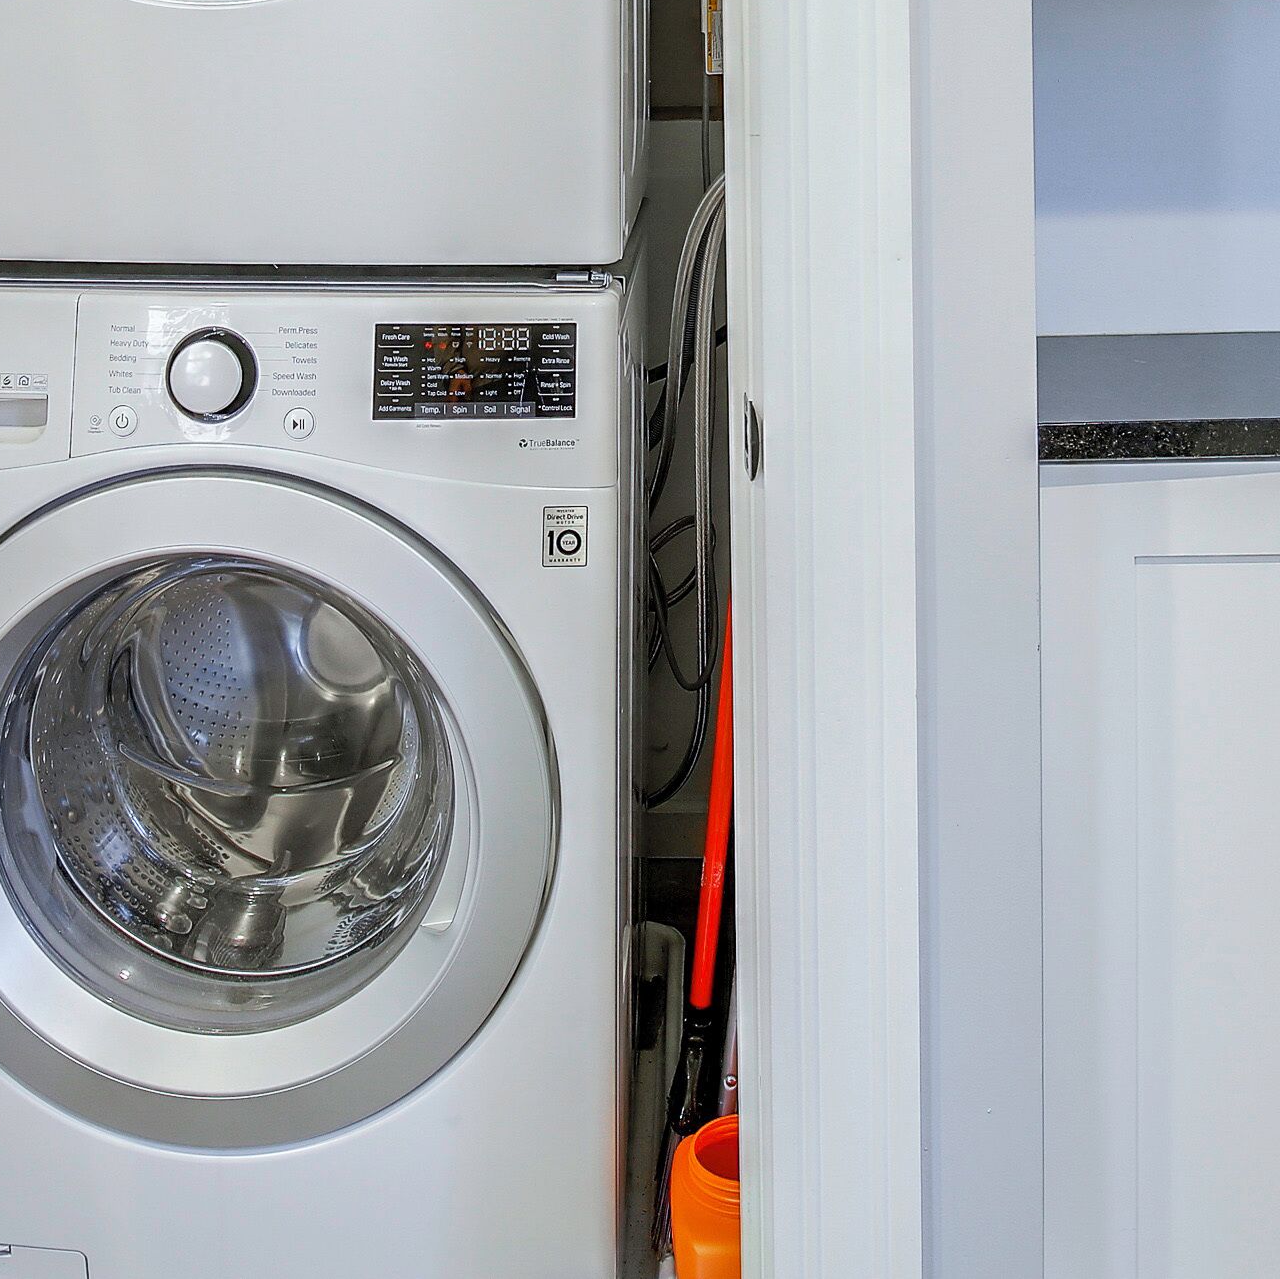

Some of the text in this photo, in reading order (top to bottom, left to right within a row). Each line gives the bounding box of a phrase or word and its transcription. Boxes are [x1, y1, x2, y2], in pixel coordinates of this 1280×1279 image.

[110, 354, 137, 362] Bedding
[272, 372, 317, 380] Speed Wash
[272, 388, 316, 396] Downloaded
[420, 406, 440, 414] Temp.
[452, 406, 467, 414] Spin
[510, 406, 531, 414] Signal
[529, 439, 575, 447] TrueBalance
[547, 529, 582, 556] 10
